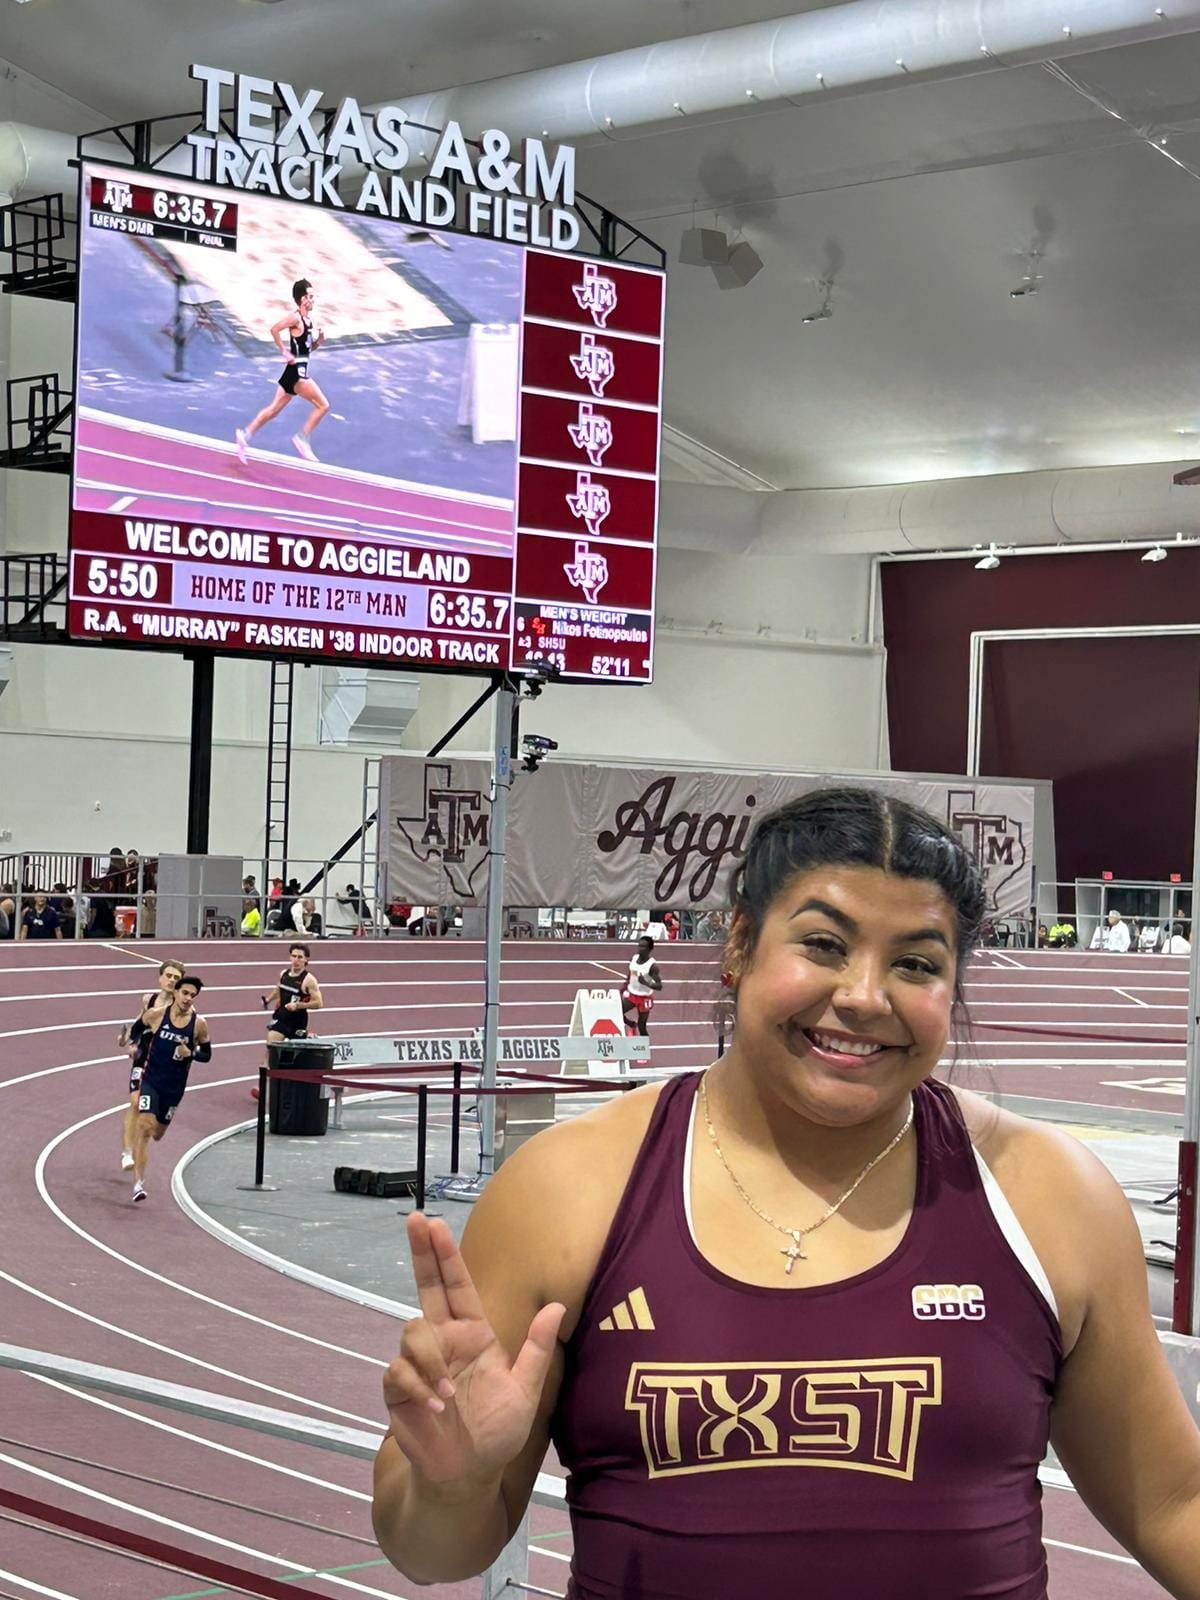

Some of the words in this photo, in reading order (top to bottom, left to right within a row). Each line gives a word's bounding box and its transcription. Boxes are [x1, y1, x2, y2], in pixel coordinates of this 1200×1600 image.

[189, 64, 409, 170] TEXAS
[430, 120, 576, 205] A&M
[153, 191, 227, 229] 6:35.7
[187, 134, 344, 207] TRACK
[357, 173, 456, 226] AND
[469, 192, 581, 251] FIELD
[92, 213, 127, 231] MEN'S
[128, 220, 154, 236] DMR
[125, 520, 270, 564] WELCOME
[278, 537, 315, 568] TO
[319, 542, 471, 583] AGGIELAND
[87, 559, 158, 598] 5:50
[190, 575, 246, 603] HOME
[252, 580, 276, 606] OF
[282, 583, 320, 609] THE
[366, 591, 407, 617] MAN
[430, 592, 509, 630] 6:35.7
[540, 605, 579, 621] MEN'S
[580, 609, 628, 625] WEIGHT
[83, 608, 127, 633] R.A.
[245, 622, 324, 650] FASKEN
[359, 632, 433, 659] INDOOR
[437, 639, 500, 664] TRACK
[597, 776, 756, 901] Aggi
[393, 1040, 453, 1062] TEXAS
[459, 1039, 486, 1061] A&
[502, 1039, 561, 1060] AGGIES
[634, 1364, 932, 1468] TXST
